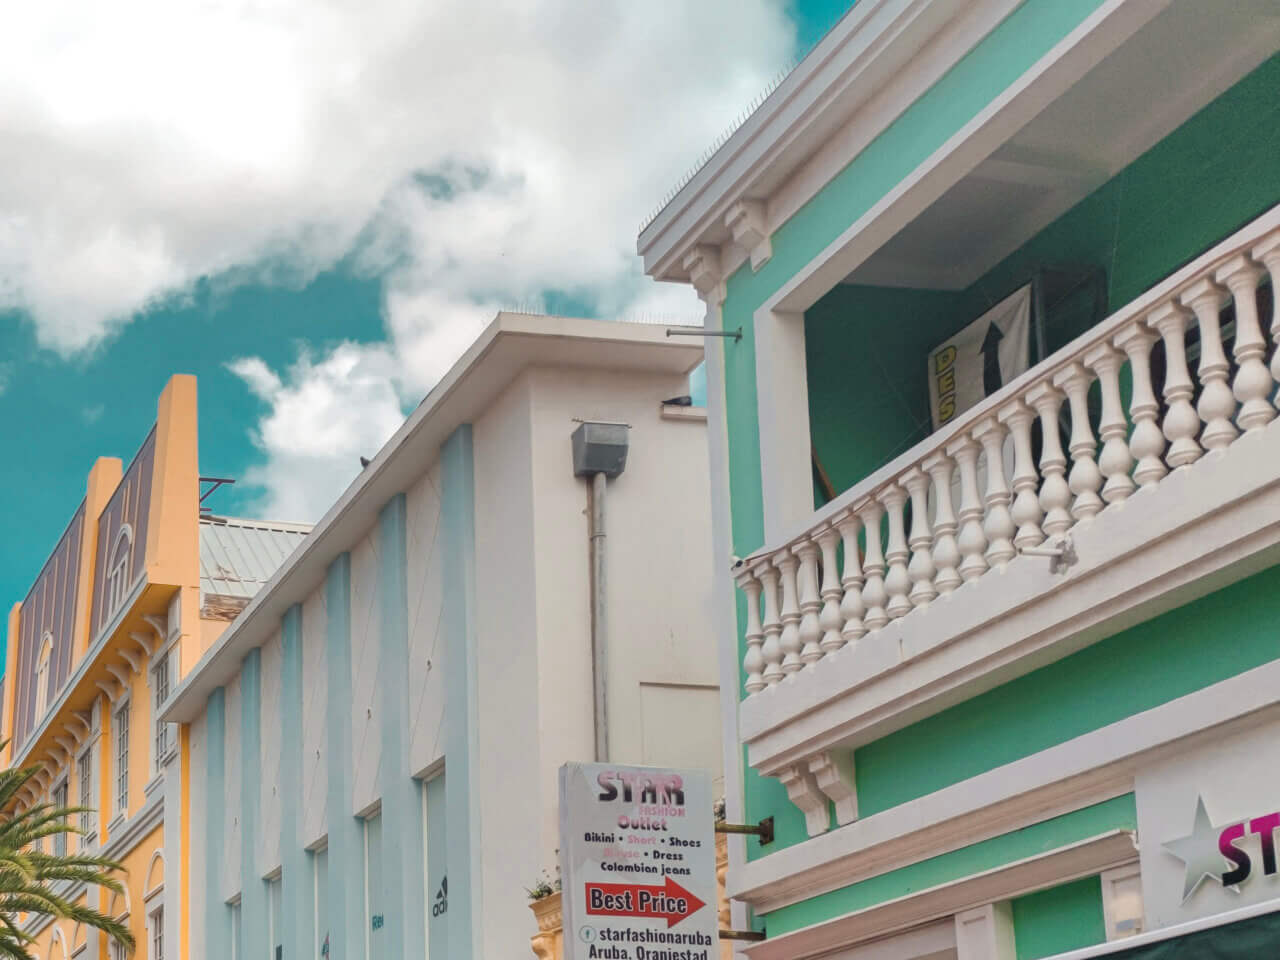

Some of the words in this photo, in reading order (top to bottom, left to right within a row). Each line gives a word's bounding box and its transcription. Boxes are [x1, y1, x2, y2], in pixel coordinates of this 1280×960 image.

[596, 770, 685, 806] STAR
[639, 806, 686, 817] FASHION
[617, 815, 669, 832] Outlet
[584, 832, 615, 843] Bikini
[627, 834, 657, 845] Short
[669, 837, 702, 848] Shoes
[652, 850, 684, 861] Dress
[600, 861, 658, 874] Colombian
[660, 863, 692, 876] jeans
[590, 888, 634, 911] Best
[637, 890, 688, 914] Price
[599, 926, 713, 946] starfashionaruba
[588, 943, 632, 960] Aruba,
